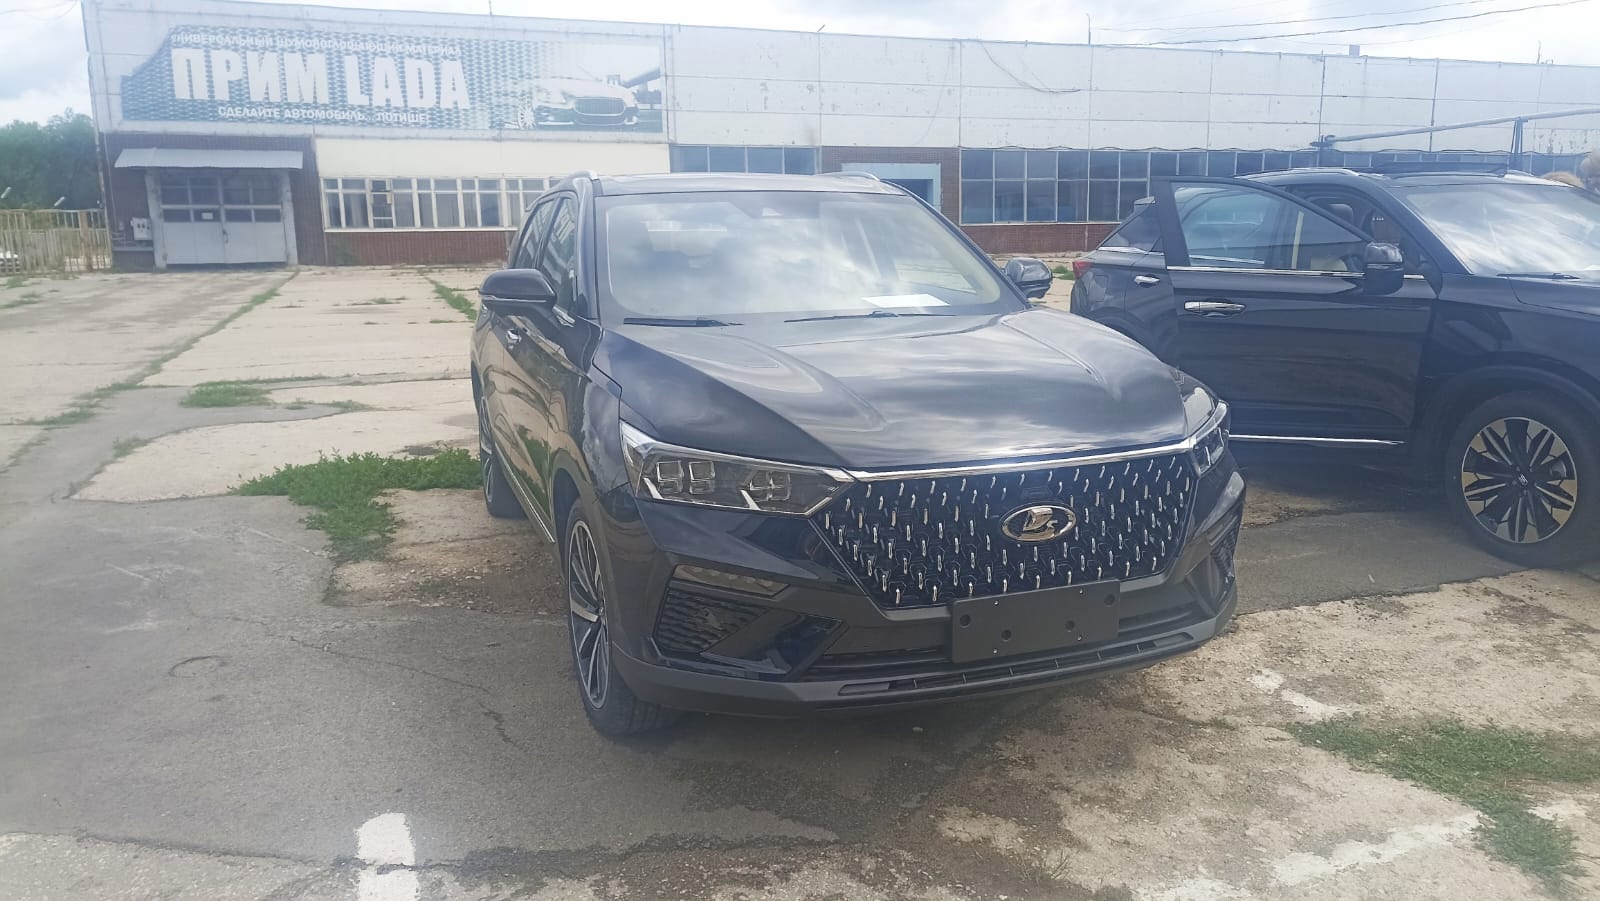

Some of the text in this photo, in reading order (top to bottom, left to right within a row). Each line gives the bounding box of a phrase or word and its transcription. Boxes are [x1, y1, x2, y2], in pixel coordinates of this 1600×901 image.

[171, 48, 471, 109] ПРИМ LADA
[218, 106, 280, 119] СДЕЛАЙТЕ
